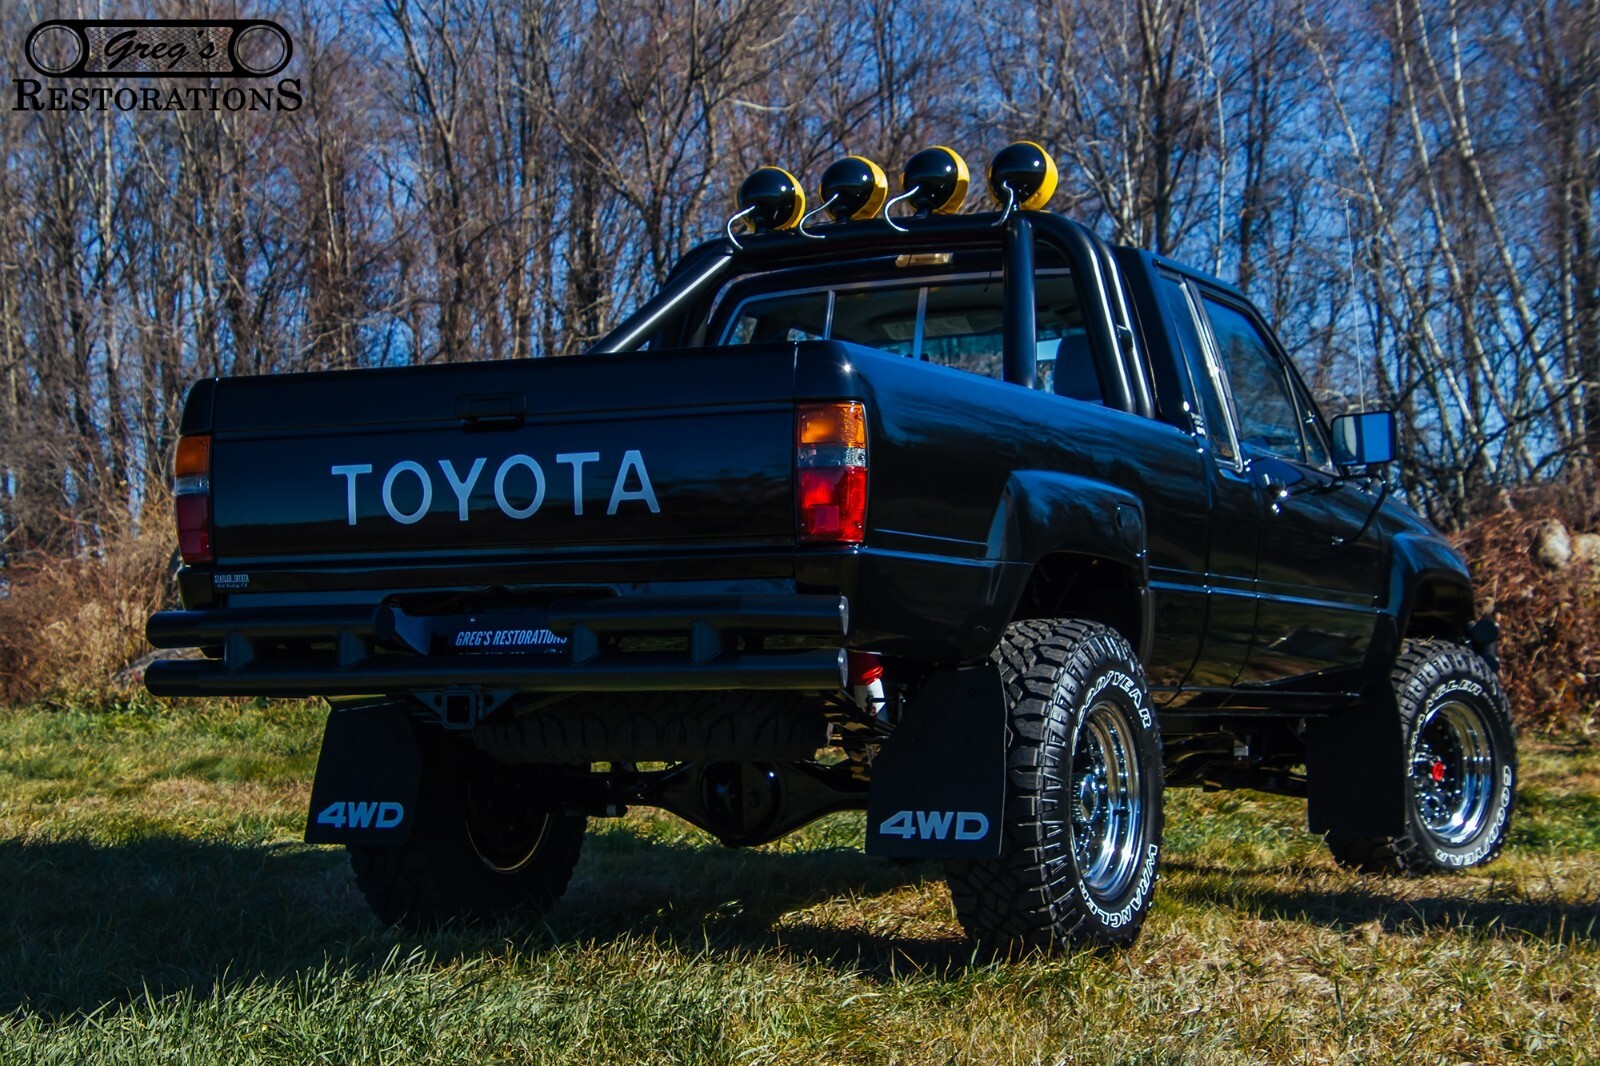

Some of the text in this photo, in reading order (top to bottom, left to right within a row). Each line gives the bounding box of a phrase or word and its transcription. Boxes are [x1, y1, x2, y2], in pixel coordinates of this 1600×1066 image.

[331, 450, 660, 525] TOYOTA
[455, 631, 493, 646] GREG'S
[317, 802, 404, 828] 4WD
[880, 810, 989, 840] 4WD
[1435, 765, 1512, 865] GOODYEAR
[1079, 843, 1158, 928] WRANGLER
